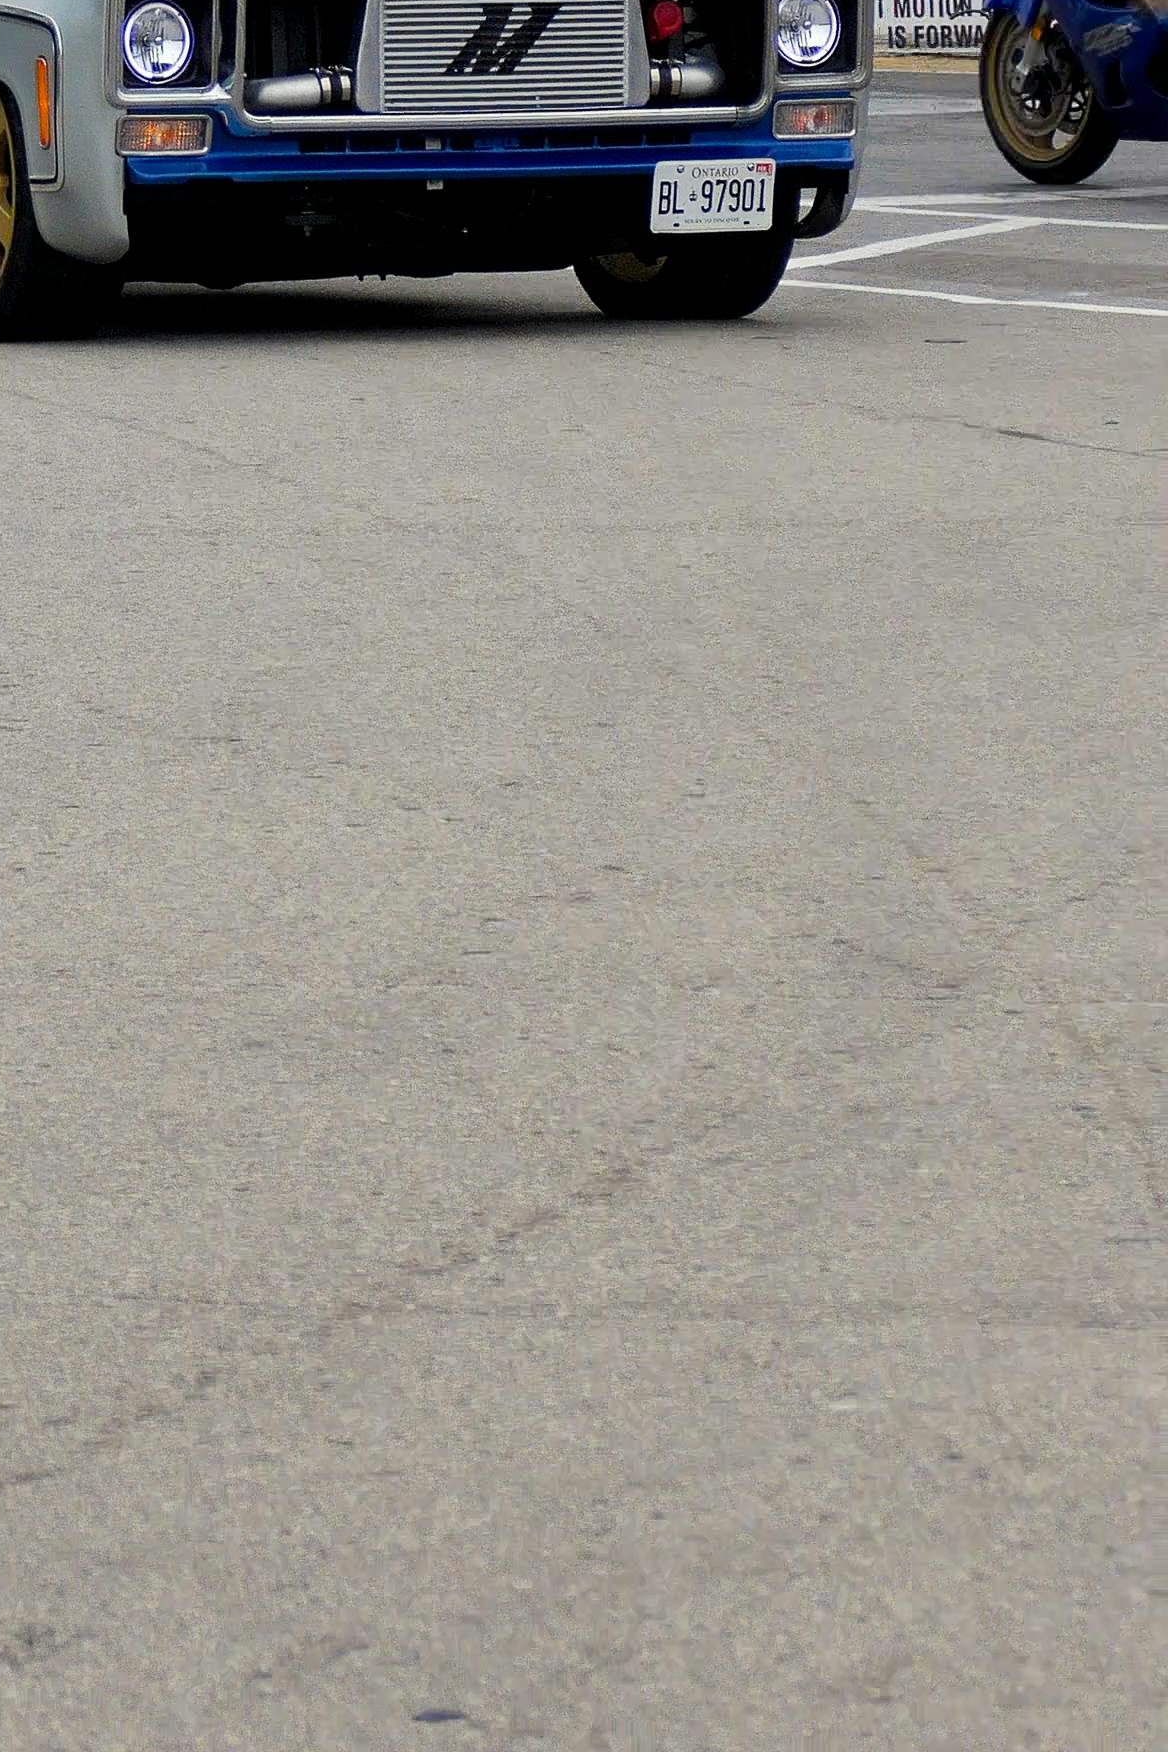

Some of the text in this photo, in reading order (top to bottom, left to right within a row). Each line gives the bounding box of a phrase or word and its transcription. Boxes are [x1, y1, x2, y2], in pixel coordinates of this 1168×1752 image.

[888, 25, 984, 49] IS FORWA
[691, 166, 739, 179] ONTARIO
[658, 178, 766, 215] BL 97901
